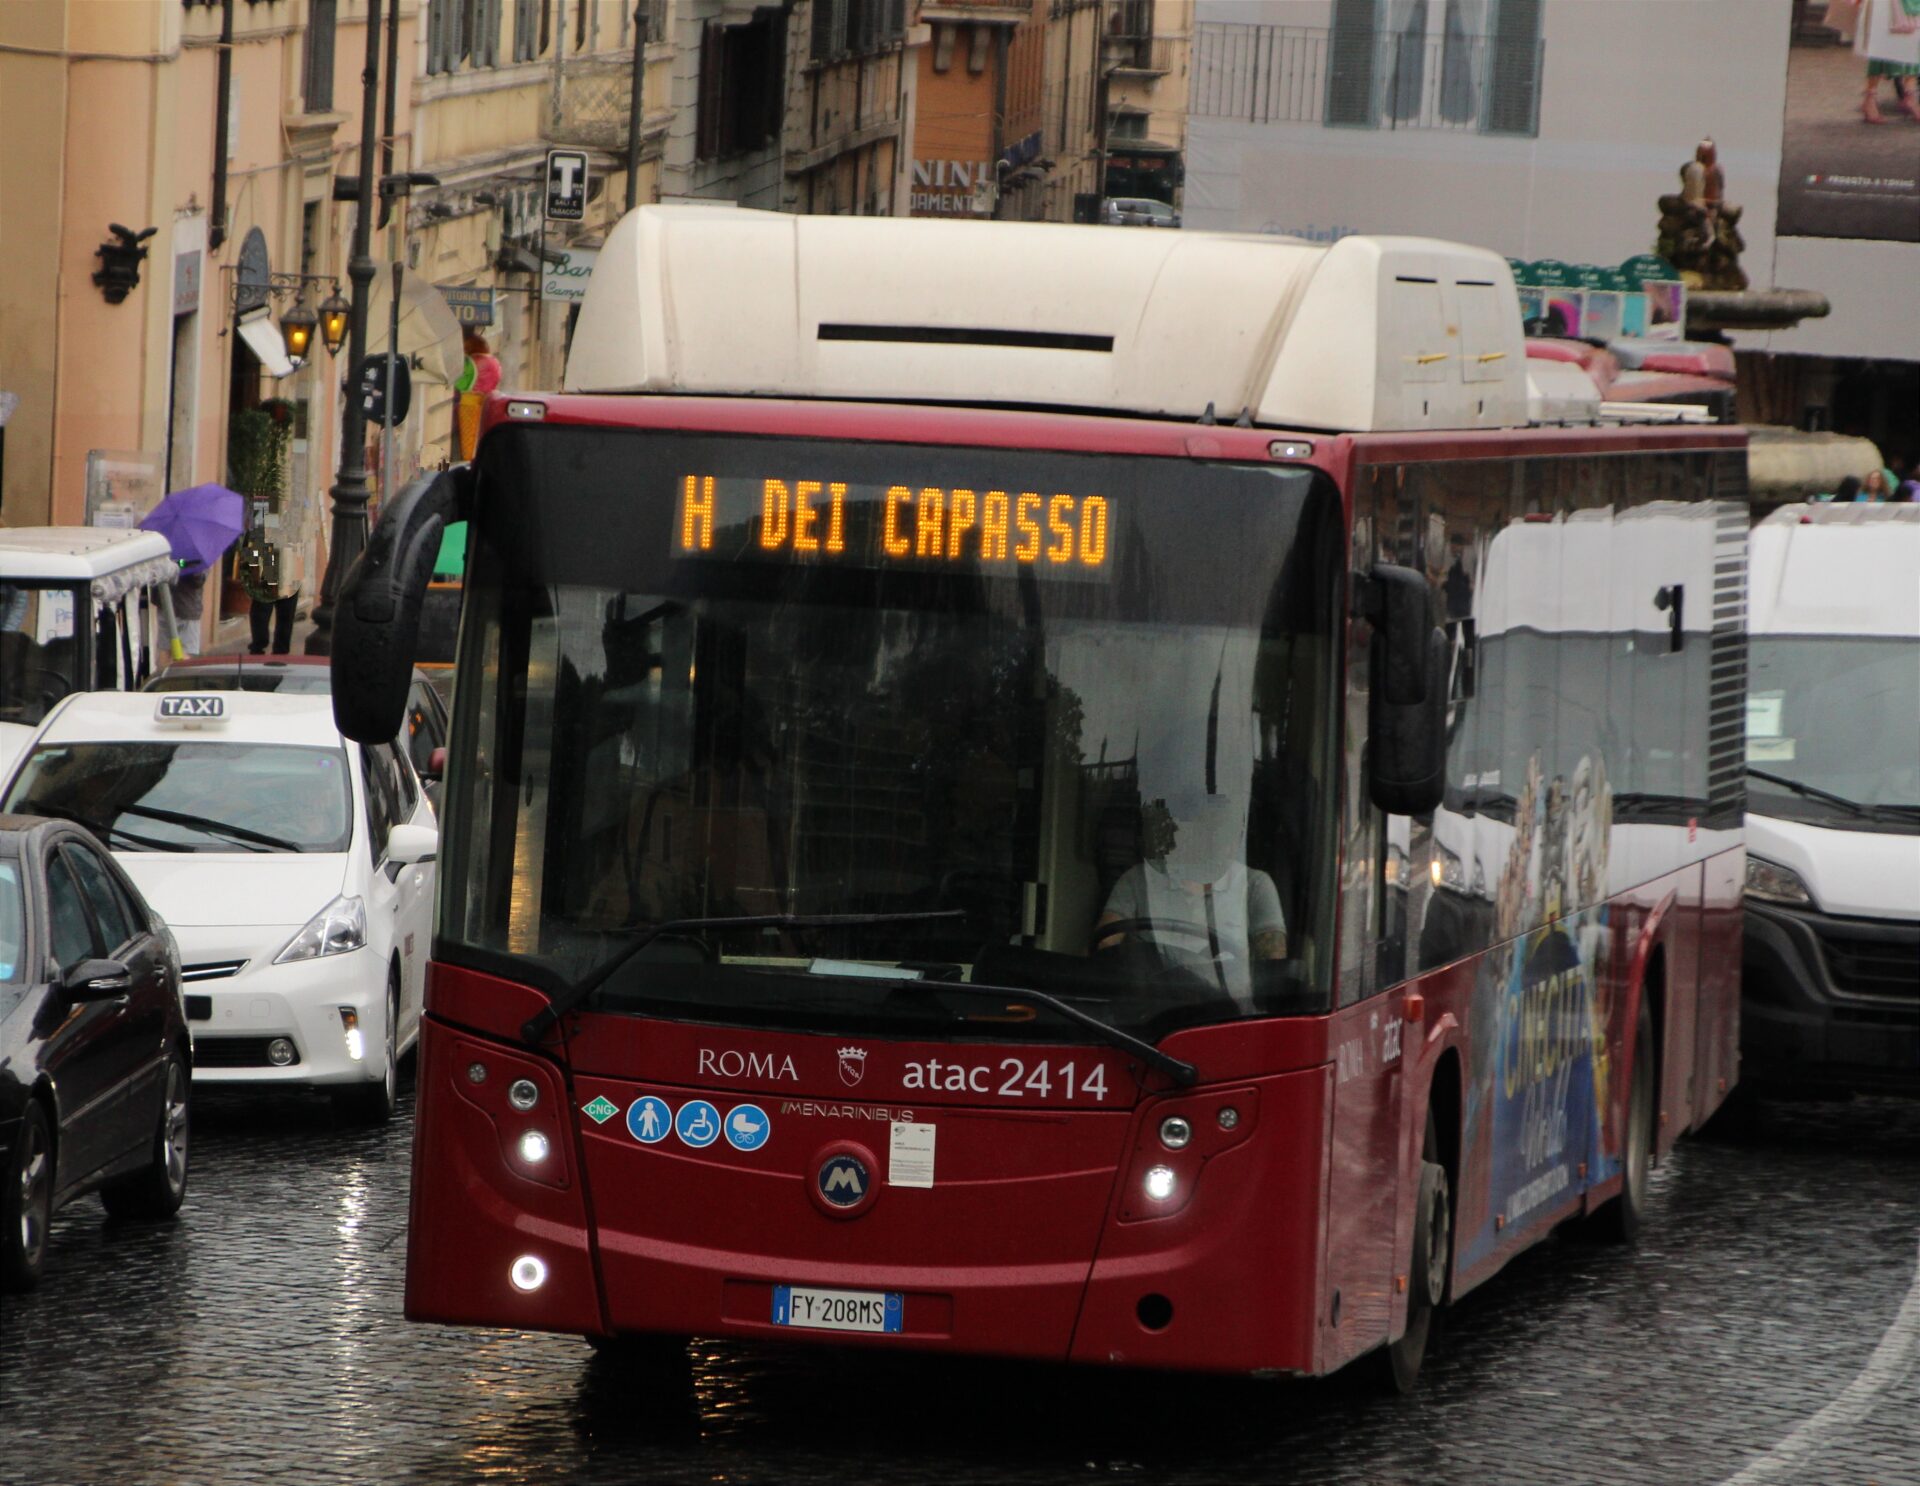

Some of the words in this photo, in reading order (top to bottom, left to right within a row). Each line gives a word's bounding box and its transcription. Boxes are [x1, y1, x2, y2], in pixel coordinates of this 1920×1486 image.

[554, 156, 581, 198] T
[547, 253, 592, 277] Bar
[683, 475, 714, 549] H
[761, 479, 846, 551] DEI
[884, 486, 1108, 564] CAPASSO
[164, 699, 220, 714] TAXI
[698, 1048, 800, 1081] ROMA
[902, 1058, 990, 1093] atac
[998, 1058, 1109, 1101] 2414
[588, 1104, 612, 1115] CNG
[786, 1102, 914, 1122] MENARINIBUS
